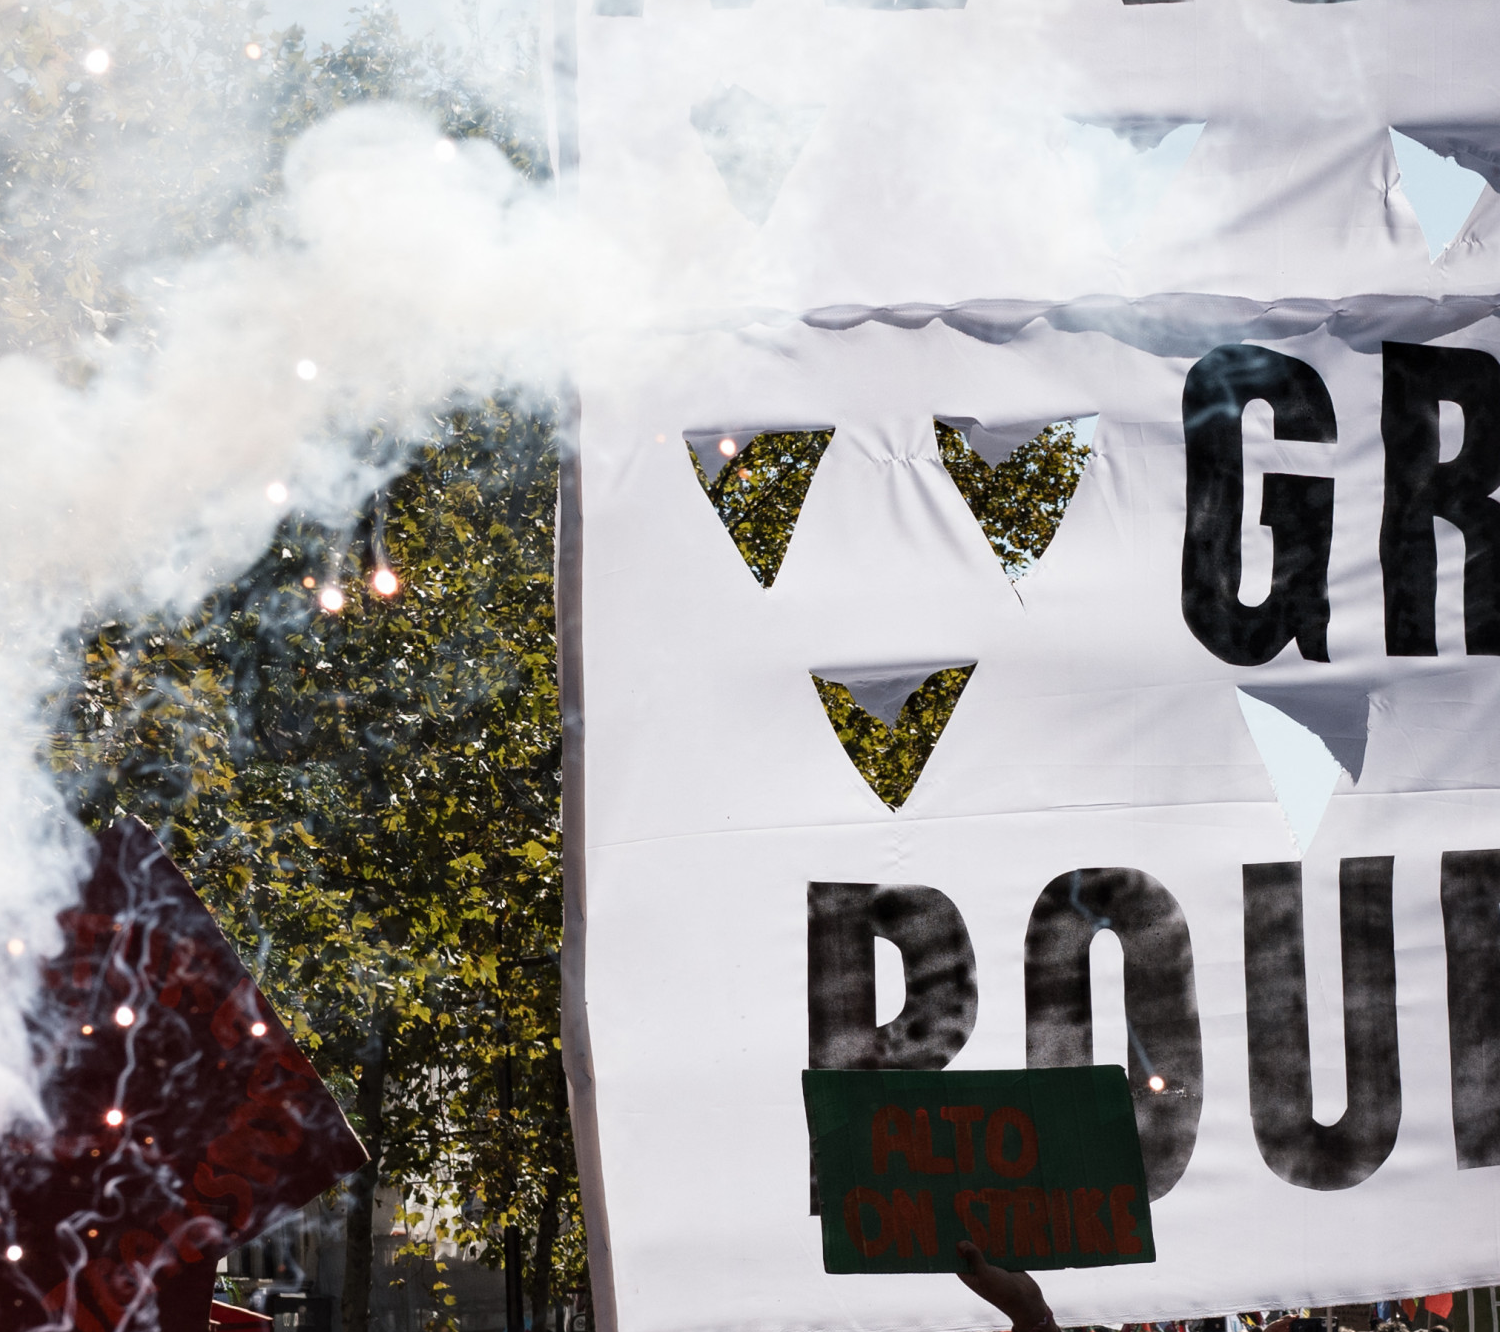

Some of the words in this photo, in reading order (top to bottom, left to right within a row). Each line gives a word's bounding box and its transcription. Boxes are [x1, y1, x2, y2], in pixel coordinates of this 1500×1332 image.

[872, 1104, 1040, 1177] ALTO
[843, 1186, 938, 1257] ON
[954, 1184, 1142, 1256] STRIKE
